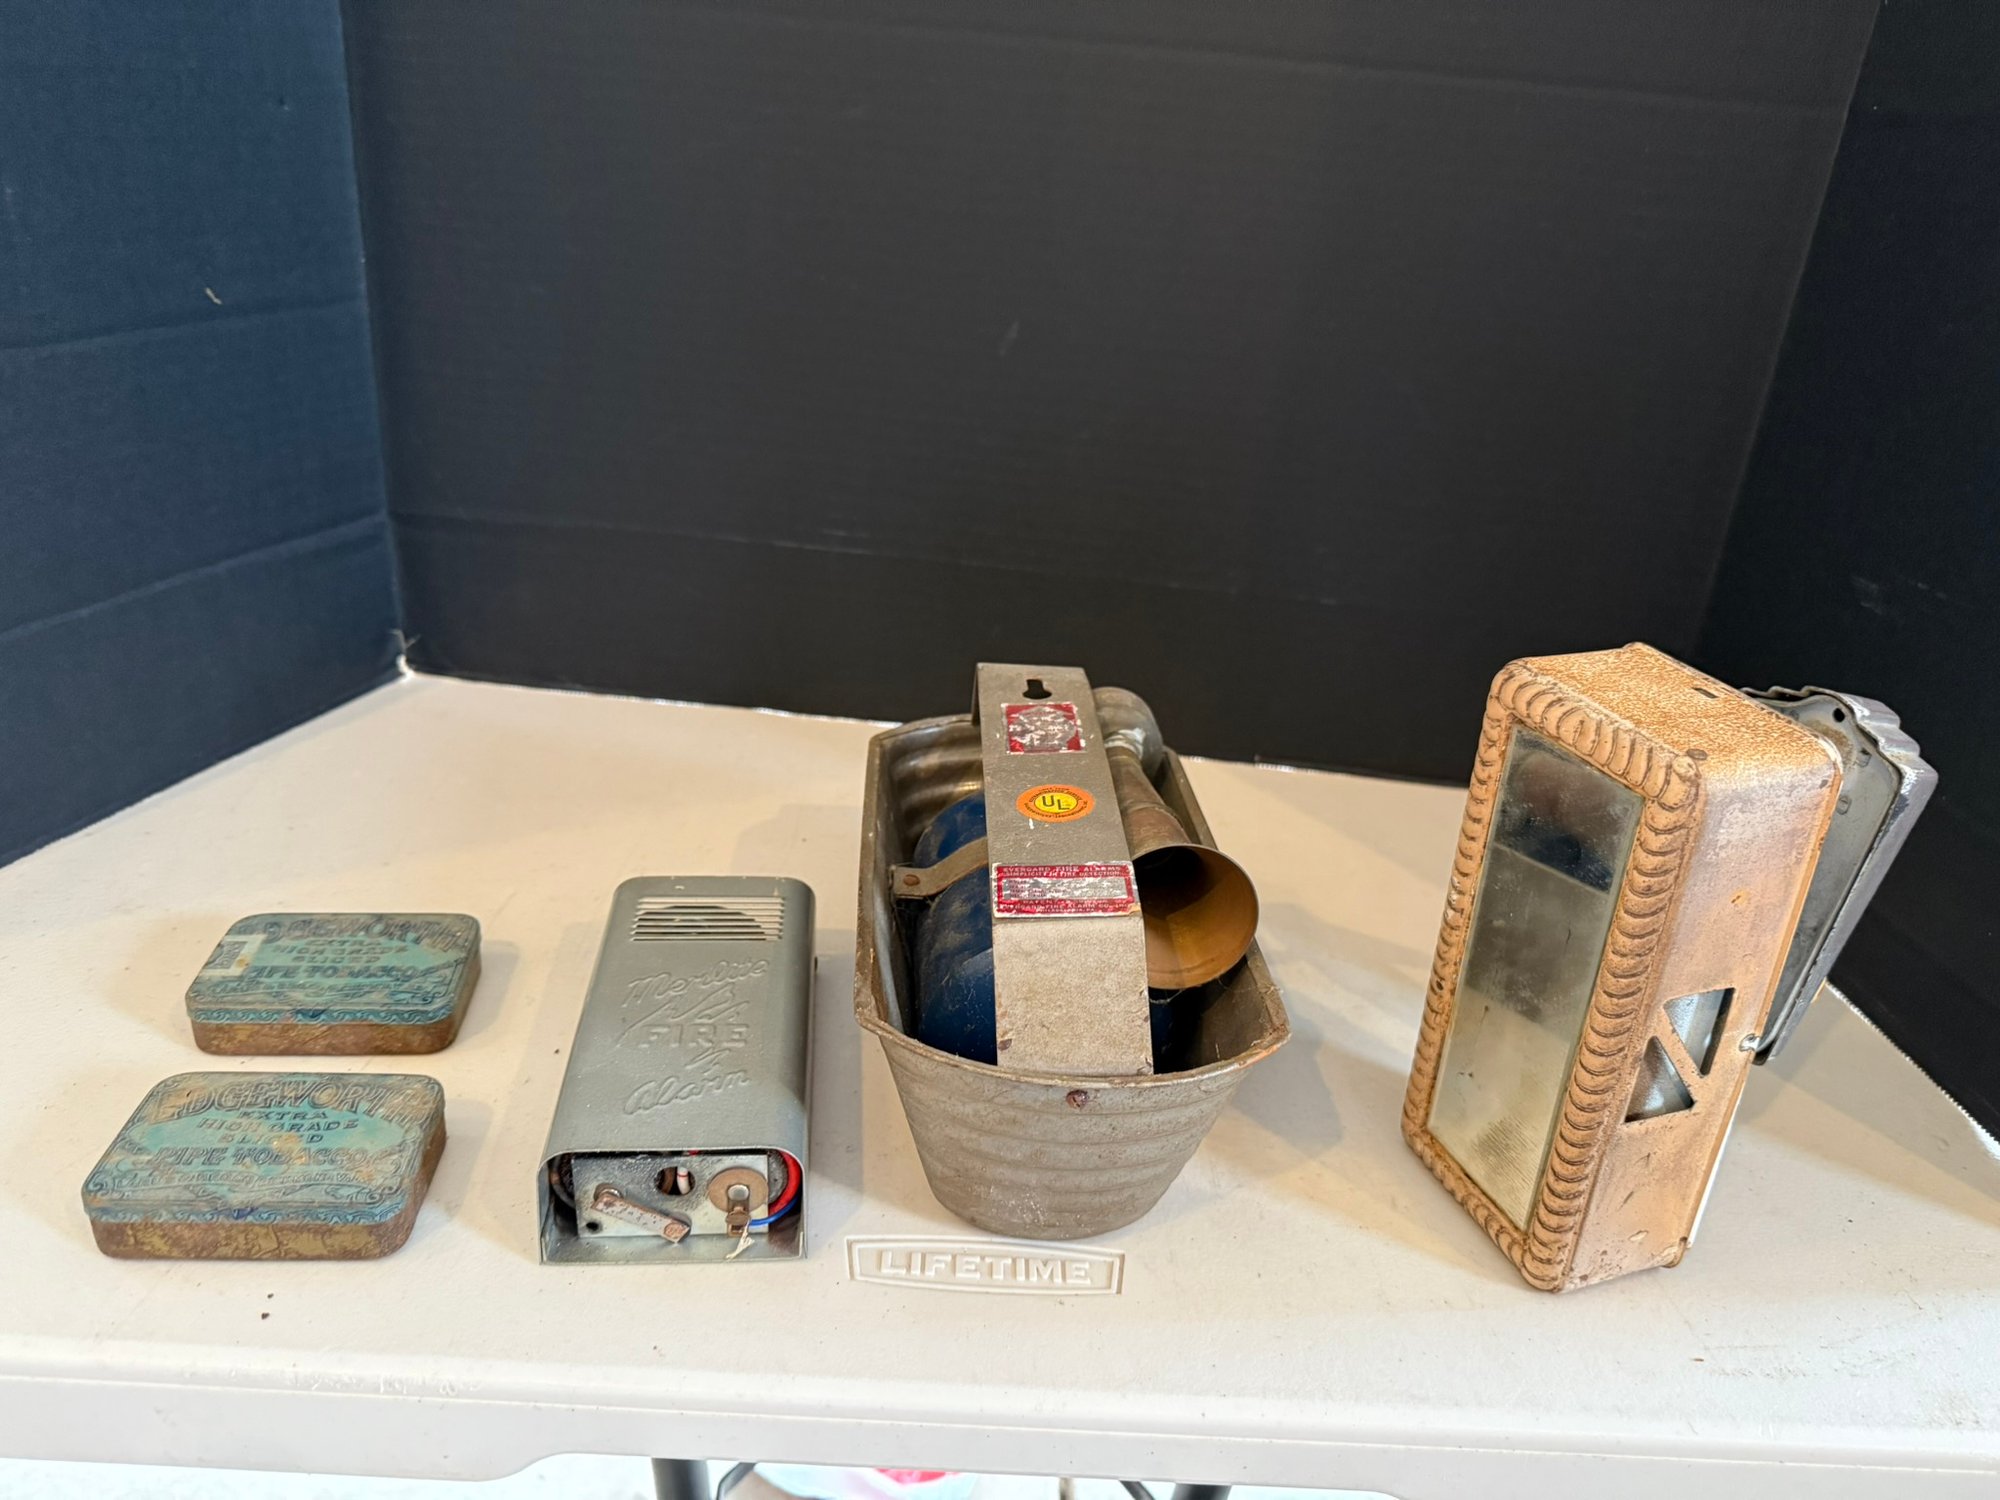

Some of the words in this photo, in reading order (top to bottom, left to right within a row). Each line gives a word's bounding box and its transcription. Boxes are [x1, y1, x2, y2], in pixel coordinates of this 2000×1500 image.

[1042, 795, 1070, 810] UL
[307, 938, 383, 947] EXTRA
[331, 944, 409, 955] GRADE
[290, 956, 382, 965] SLICED
[308, 965, 417, 983] TOBACCO
[637, 1022, 751, 1048] FIRE
[623, 1069, 752, 1115] Alarm
[150, 1078, 428, 1129] EDGEWORTH
[237, 1110, 329, 1121] EXTRA
[195, 1118, 262, 1131] HIGH
[267, 1118, 361, 1132] GRADE
[149, 1146, 227, 1167] PIPE
[230, 1146, 368, 1167] TOBACCO
[879, 1249, 1091, 1285] LIFETIME
